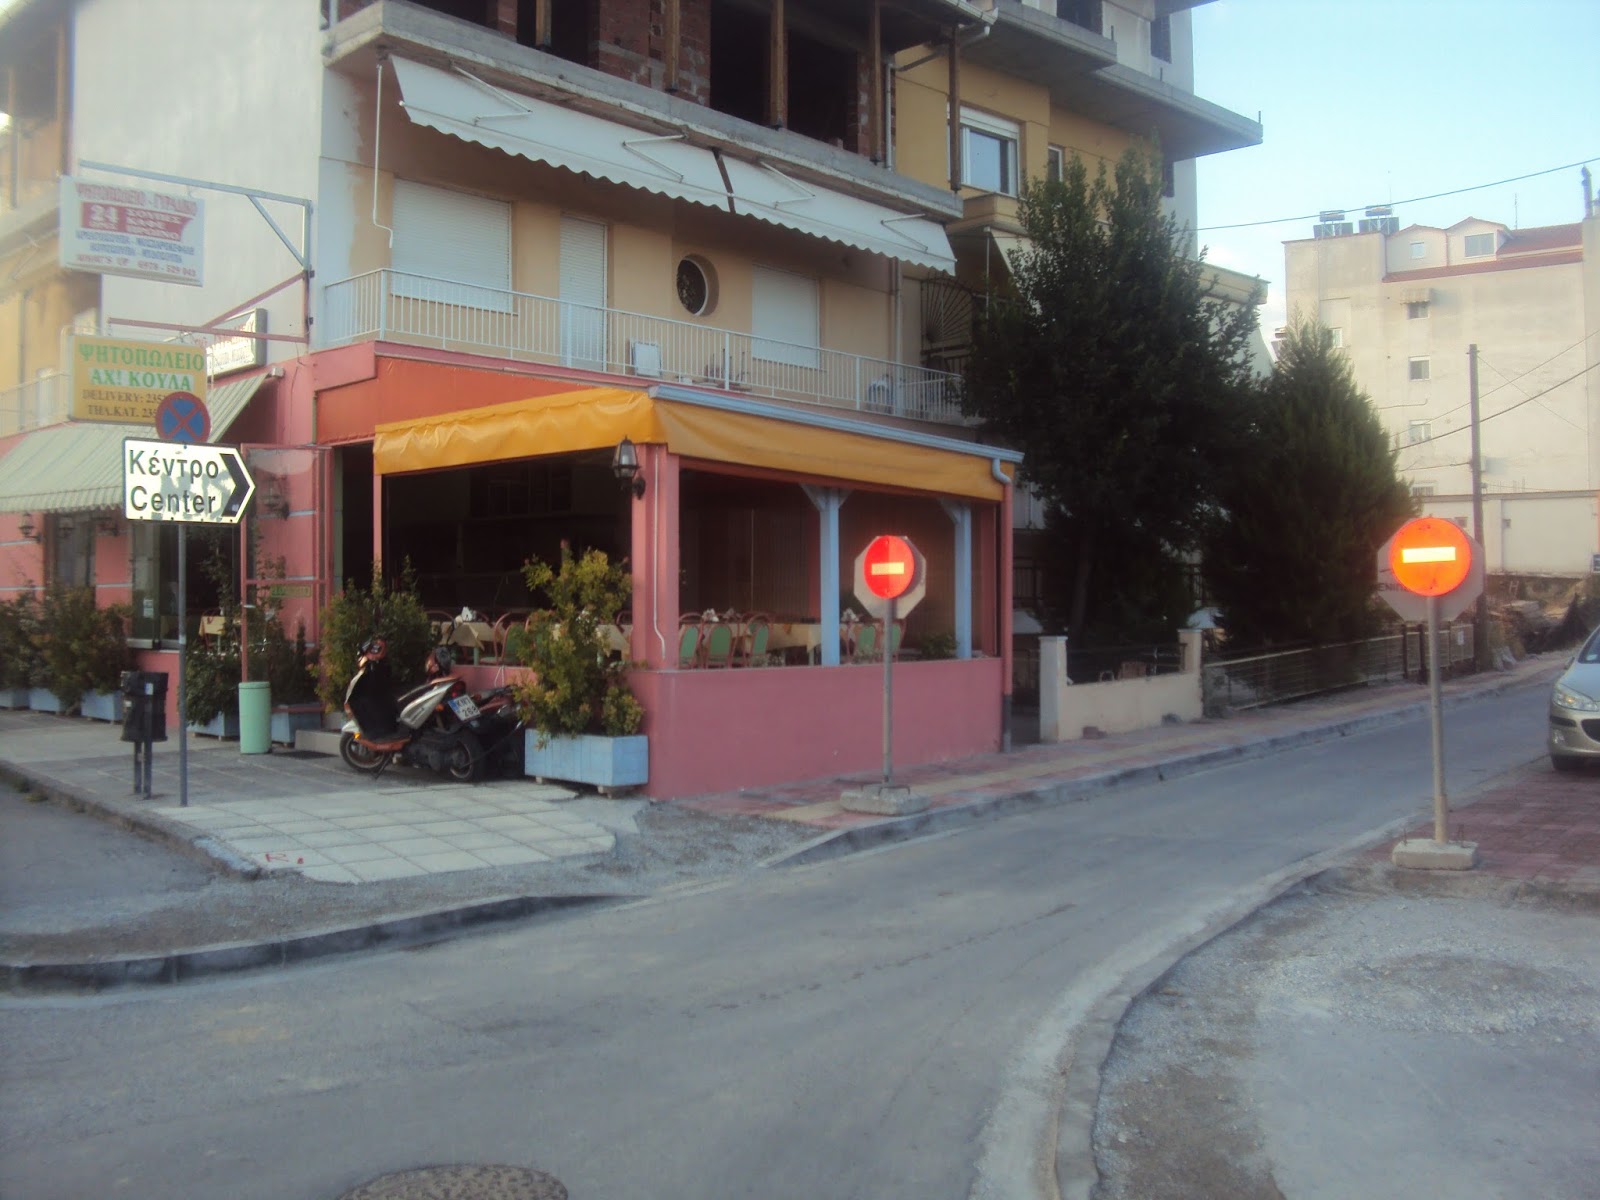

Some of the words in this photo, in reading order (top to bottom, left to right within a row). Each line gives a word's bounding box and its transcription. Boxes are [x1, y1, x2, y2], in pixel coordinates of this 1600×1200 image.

[90, 204, 118, 222] 24
[79, 343, 205, 372] ΨΗΤΟΠΩΛΕΙΟ
[128, 370, 192, 391] ΚΟΥΛΑ
[129, 449, 219, 484] Κέντρο
[130, 485, 216, 513] Center
